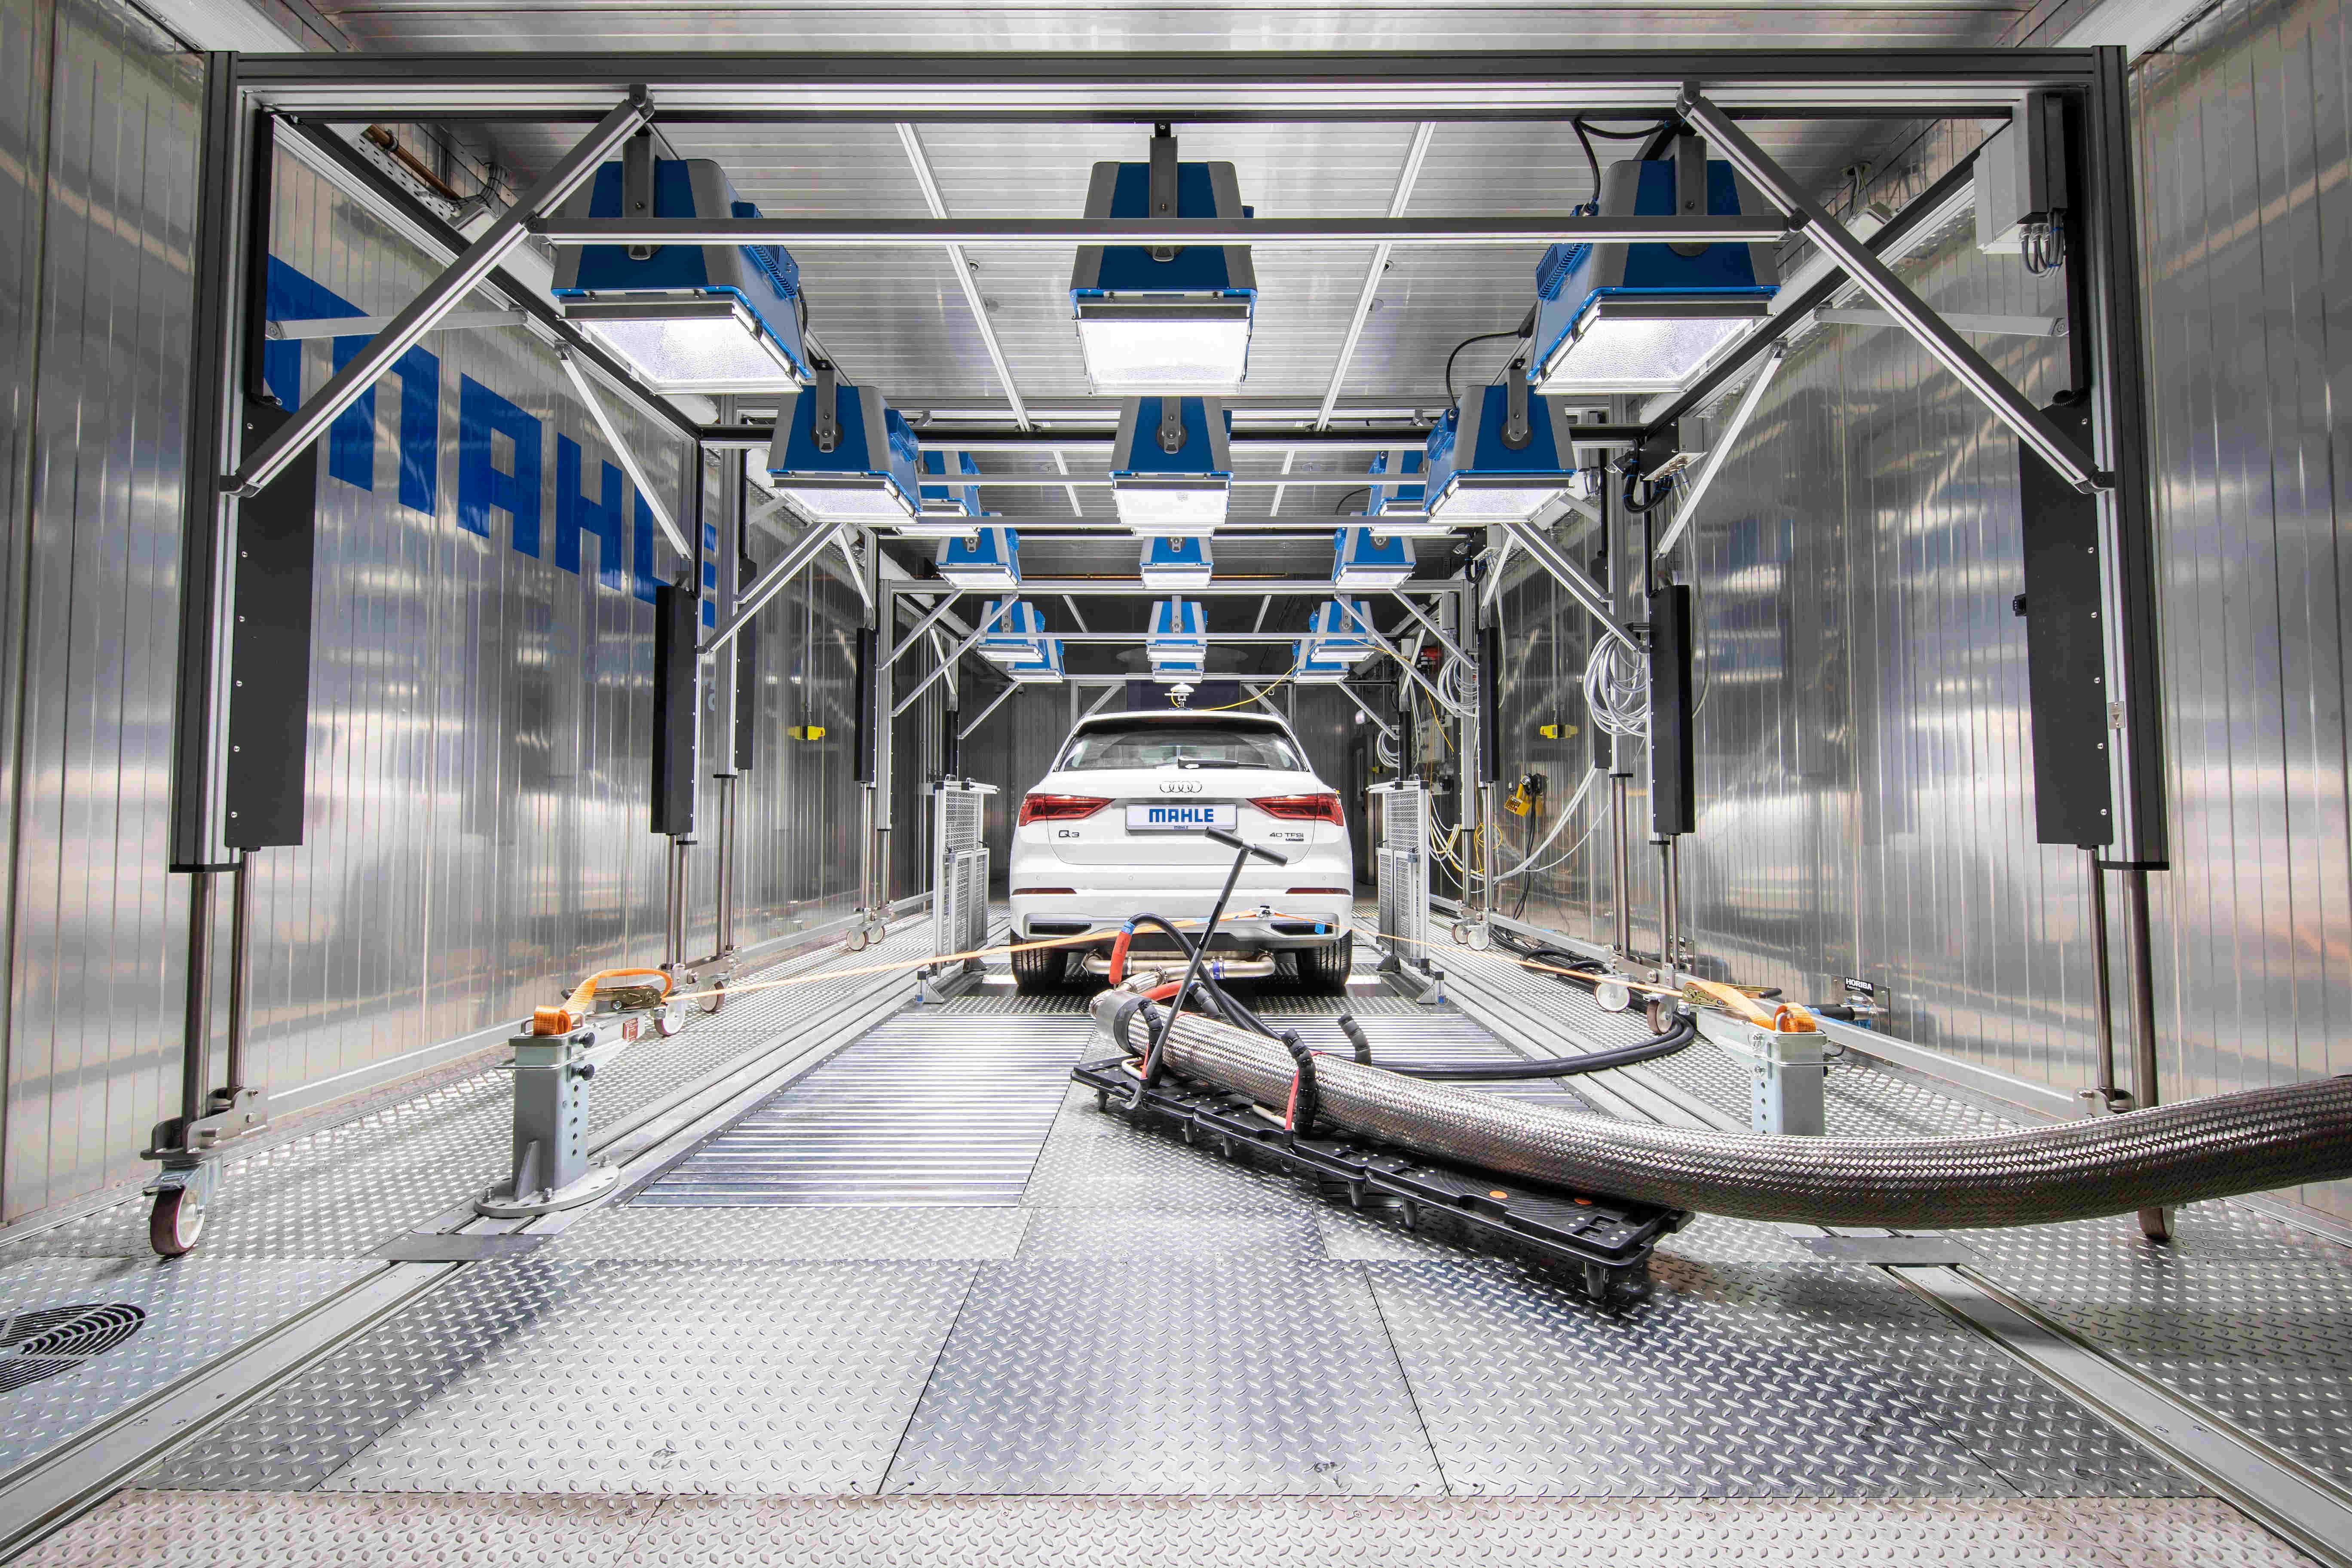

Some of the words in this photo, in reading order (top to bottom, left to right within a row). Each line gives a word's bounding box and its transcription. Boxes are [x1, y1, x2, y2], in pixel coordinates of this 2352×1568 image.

[1149, 808, 1214, 823] MAHLE
[1059, 830, 1080, 838] Q3
[1845, 977, 1872, 991] HORIBA
